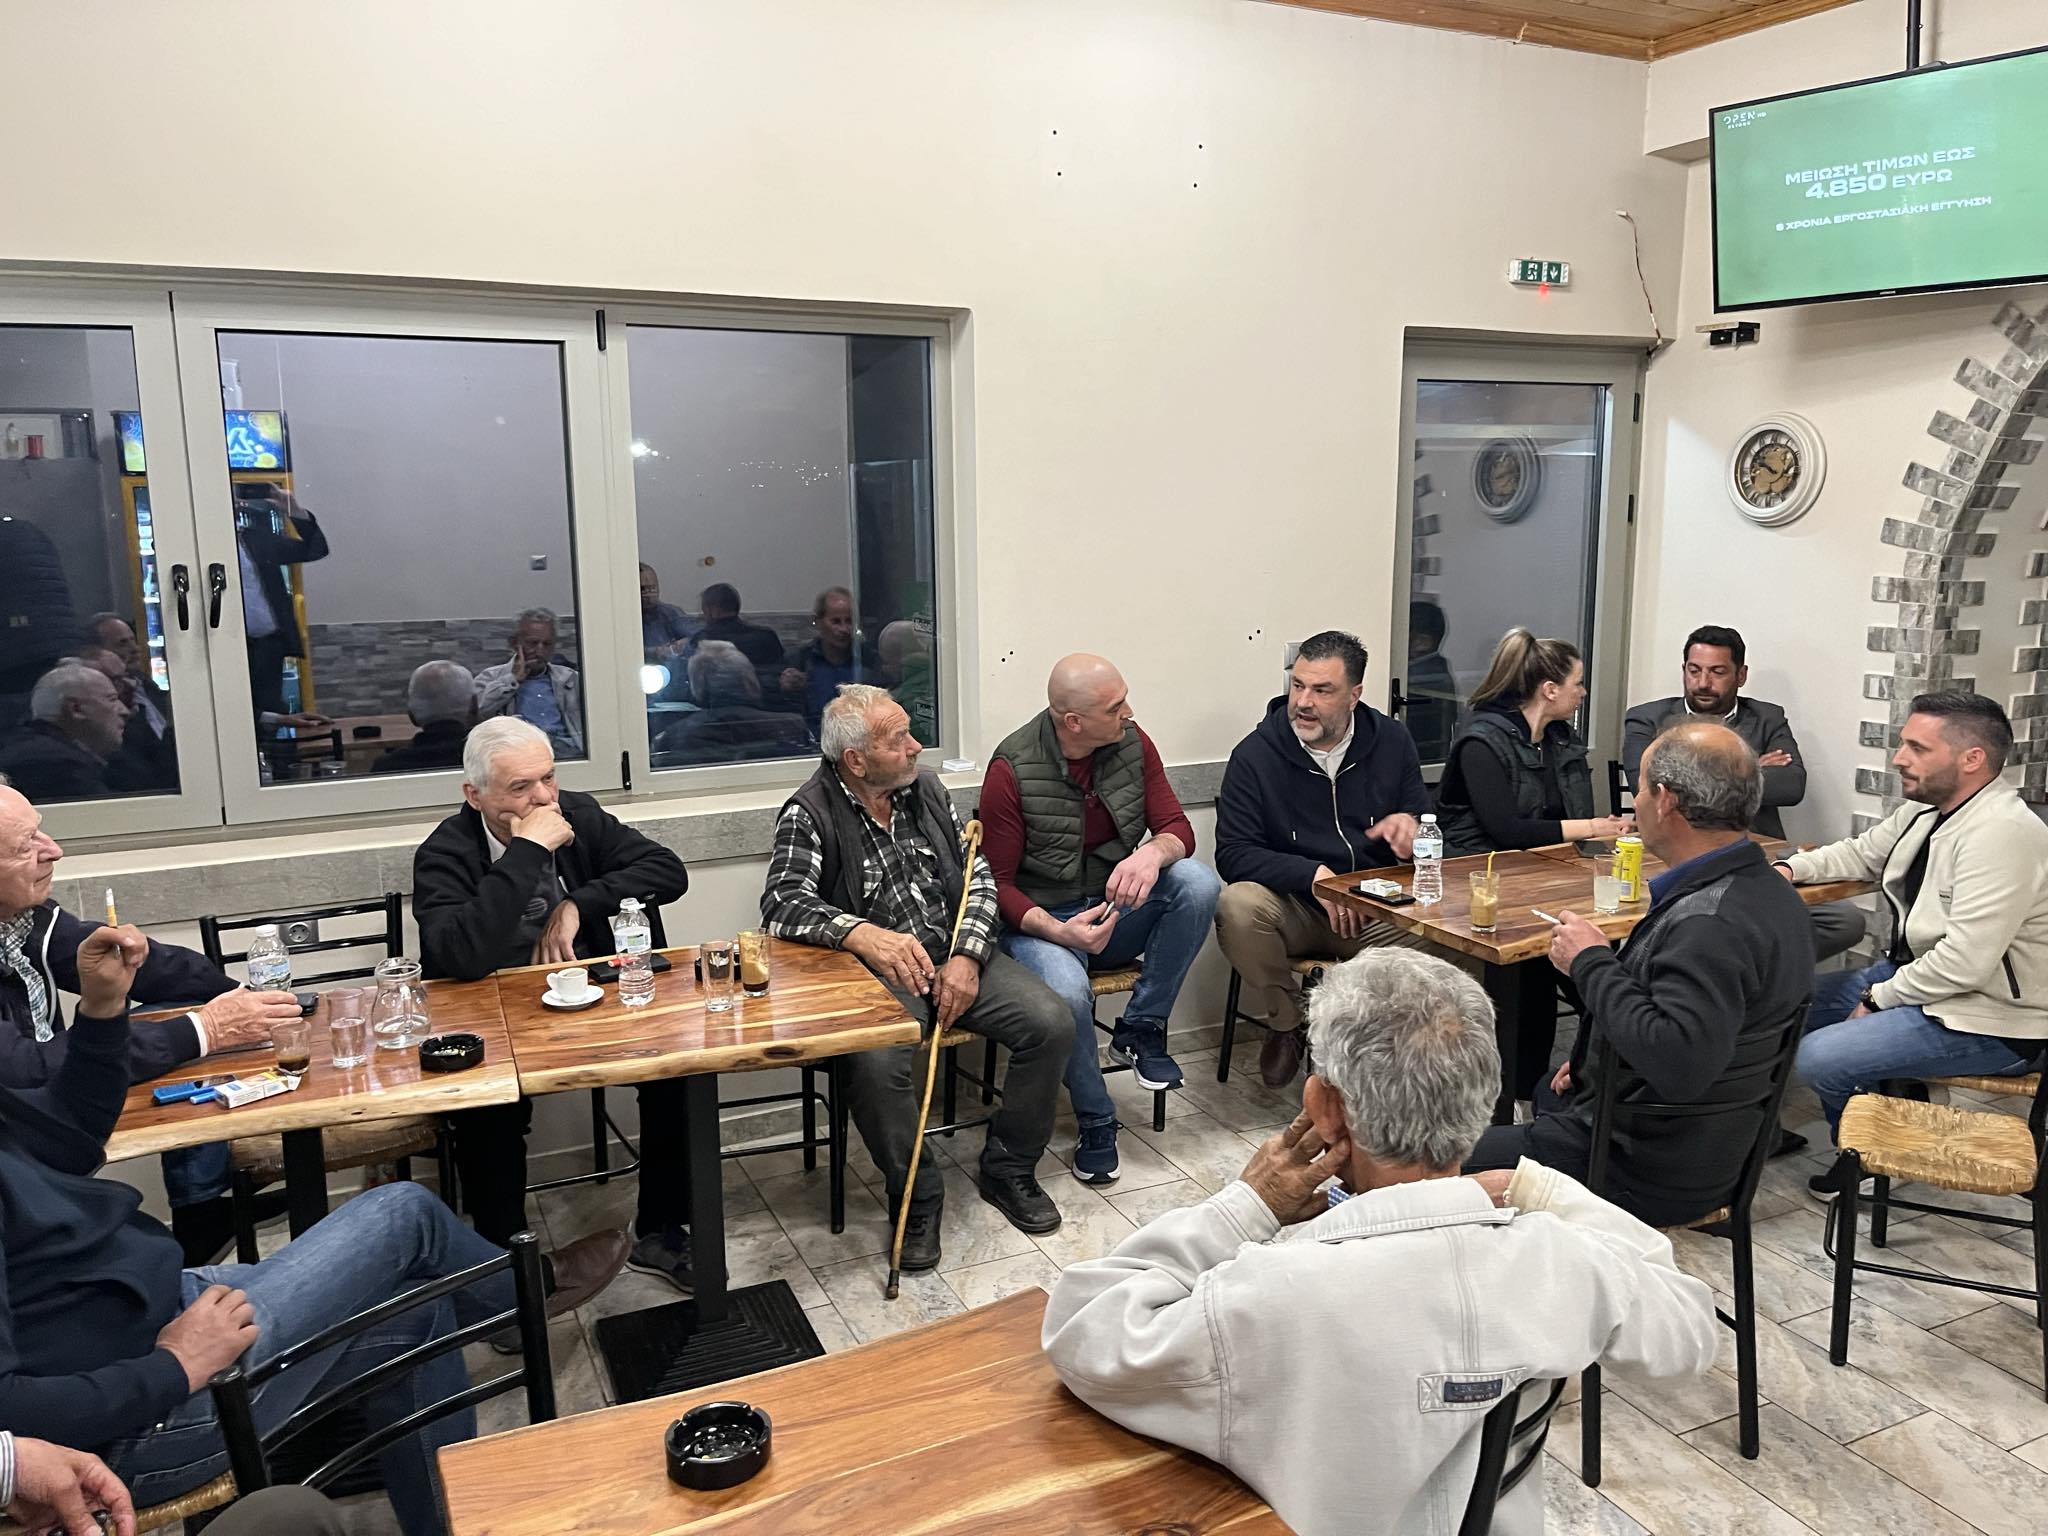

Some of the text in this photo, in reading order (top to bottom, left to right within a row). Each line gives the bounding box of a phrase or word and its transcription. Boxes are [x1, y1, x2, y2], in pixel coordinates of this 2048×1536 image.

[1723, 111, 1756, 125] OPEN
[1785, 146, 1976, 186] ΜΕΙΩΣΗ ΤΙΜΩΝ ΕΩΣ
[1805, 168, 1953, 199] 4.850 ΕΥΡΩ
[1785, 216, 1832, 231] ΧΡΟΝΙΑ
